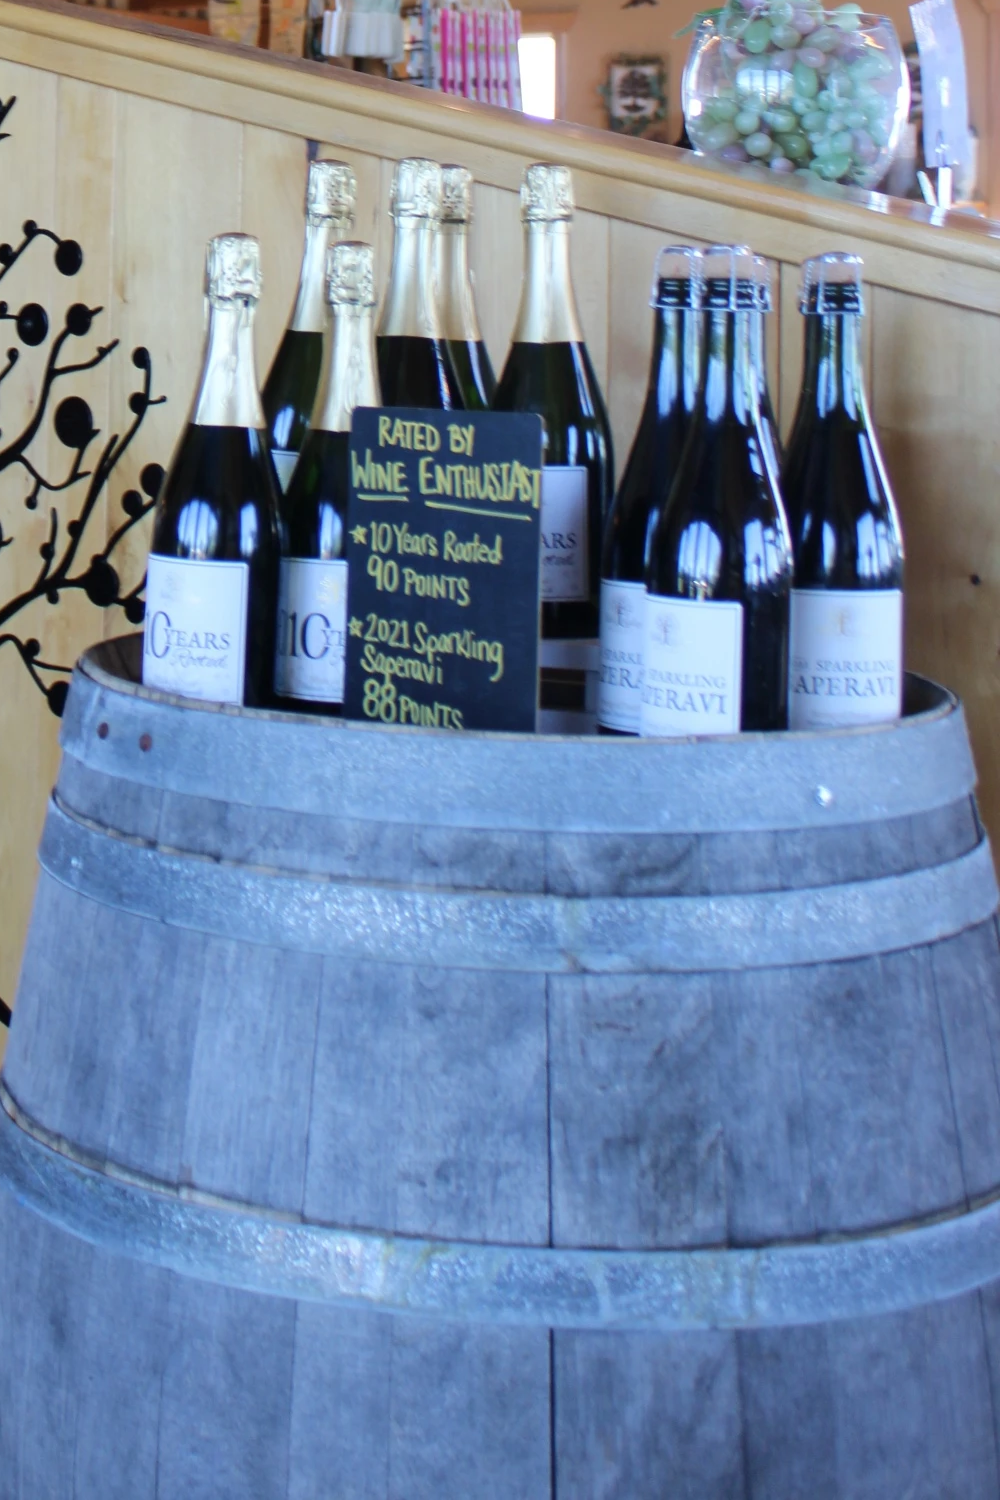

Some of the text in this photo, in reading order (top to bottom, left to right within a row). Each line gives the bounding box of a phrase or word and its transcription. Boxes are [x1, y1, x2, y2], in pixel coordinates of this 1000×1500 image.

[378, 415, 475, 457] RATED BY
[351, 449, 541, 508] WINE ENTHUSIAST
[369, 521, 503, 565] 10 Years Rooted
[367, 555, 470, 607] 90 POINTS
[360, 644, 443, 687] Saperavi
[363, 612, 504, 682] 2021 Sparkling
[363, 679, 464, 730] 88 POINTS
[794, 675, 897, 698] APERAVI
